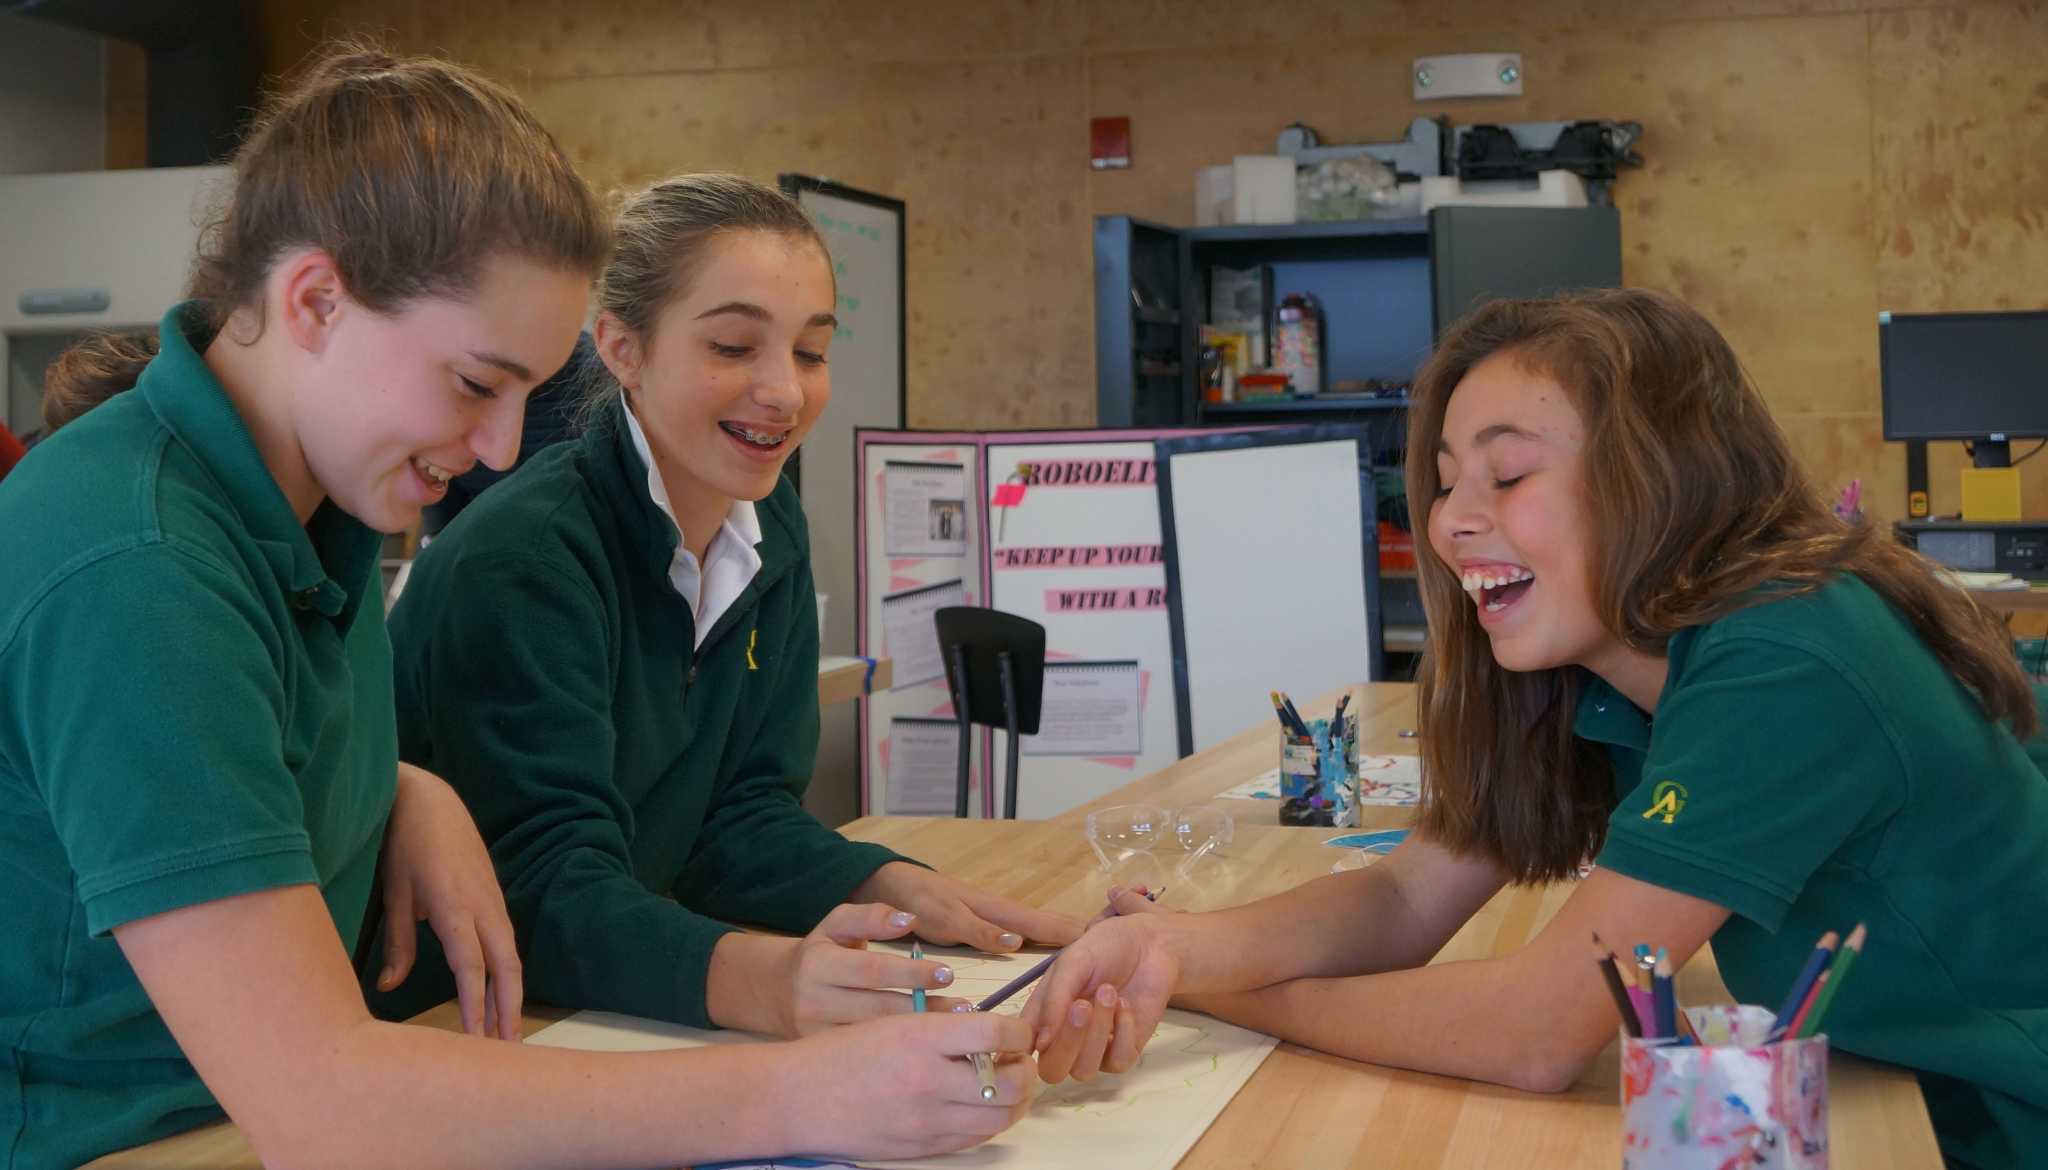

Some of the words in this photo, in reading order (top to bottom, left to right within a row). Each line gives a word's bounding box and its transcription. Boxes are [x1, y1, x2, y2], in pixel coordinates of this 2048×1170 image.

[1023, 460, 1157, 485] ROBOELI
[1069, 547, 1098, 565] UP
[1059, 590, 1117, 609] WITH
[1123, 589, 1136, 607] A
